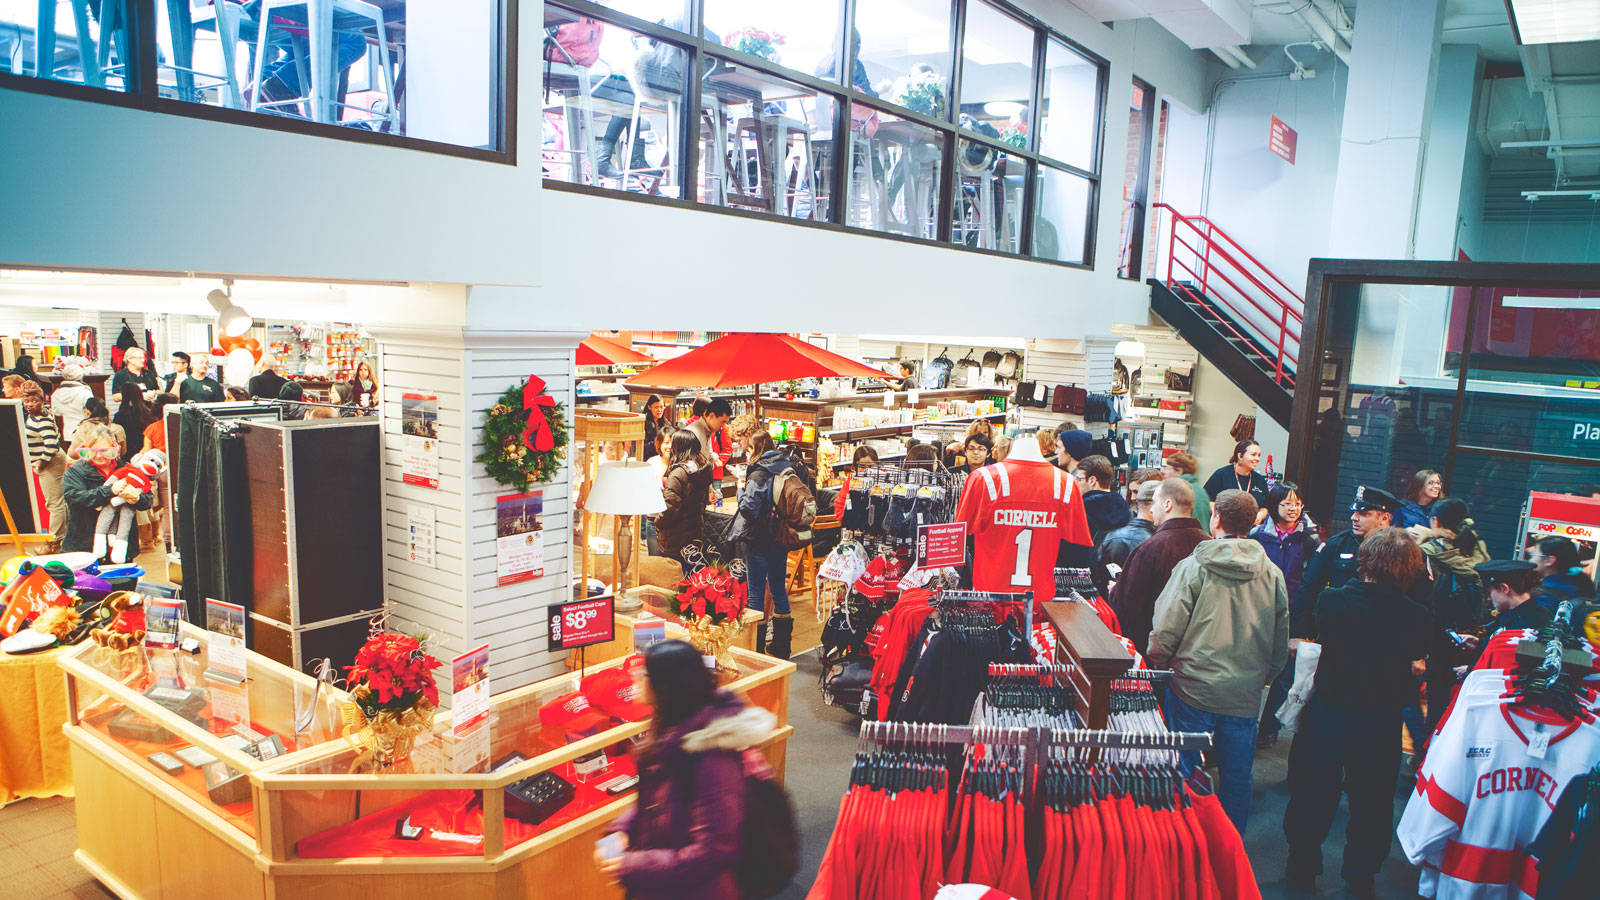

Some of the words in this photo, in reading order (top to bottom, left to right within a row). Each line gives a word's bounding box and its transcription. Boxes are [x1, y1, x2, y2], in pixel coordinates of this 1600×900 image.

[994, 509, 1058, 529] CORNELL
[917, 535, 927, 559] sale
[1010, 527, 1033, 587] 1
[577, 602, 595, 610] Football
[550, 614, 561, 641] sale
